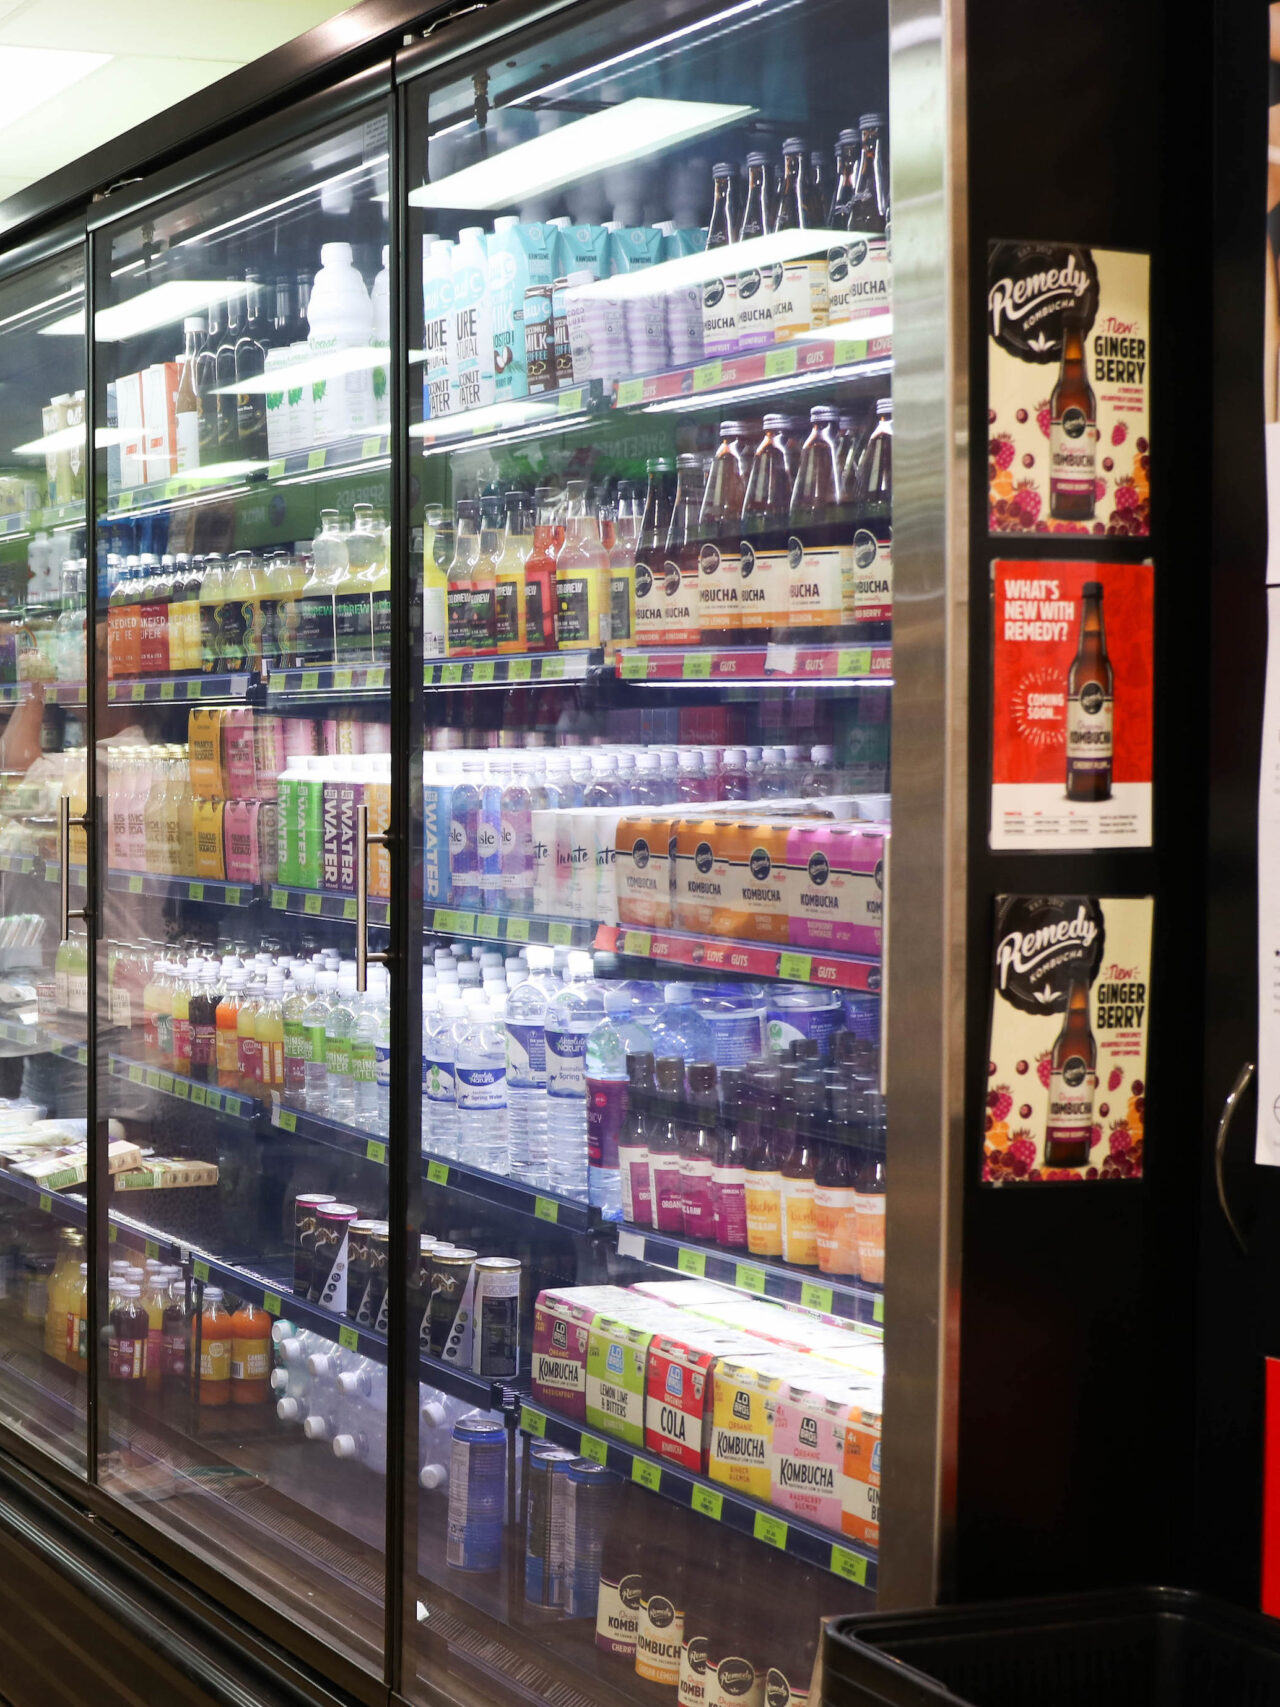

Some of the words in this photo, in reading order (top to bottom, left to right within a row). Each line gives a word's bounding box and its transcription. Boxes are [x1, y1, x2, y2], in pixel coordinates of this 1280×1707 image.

[988, 254, 1091, 337] Remedy
[1023, 299, 1075, 331] KOMBUCHA
[806, 351, 824, 364] GUTS
[1094, 336, 1146, 359] GINGER
[1095, 359, 1145, 384] BERRY
[1004, 579, 1060, 600] WHAT'S
[1004, 601, 1039, 620] NEW
[1040, 602, 1075, 621] WITH
[1004, 621, 1069, 641] REMEDY?
[805, 659, 824, 671] GUTS
[872, 657, 892, 669] LOVE
[1027, 693, 1065, 707] COMING
[278, 799, 288, 862] WATER
[298, 799, 306, 865] WATER
[324, 800, 338, 882] WATER
[341, 801, 354, 885] WATER
[424, 803, 439, 898] WATER
[627, 875, 657, 889] KOMBUCHA
[688, 880, 721, 896] KOMBUCHA
[742, 887, 781, 902] KOMBUCHA
[800, 893, 839, 910] KOMBUCHA
[652, 942, 668, 955] GUTS
[996, 905, 1098, 990] Remedy
[707, 951, 723, 963] LOVE
[731, 954, 748, 967] GUTS
[1029, 950, 1083, 984] KOMBUCHA
[818, 966, 837, 980] GUTS
[1097, 983, 1146, 1004] GINGER
[1097, 1006, 1145, 1029] BERRY
[559, 1072, 580, 1081] Spring
[539, 1357, 579, 1382] KOMBUCHA
[599, 1383, 615, 1399] LEMON
[616, 1387, 629, 1405] LIME
[737, 1393, 749, 1405] LO
[606, 1398, 627, 1418] BITTERS
[734, 1404, 750, 1416] BROS
[660, 1406, 686, 1441] COLA
[728, 1421, 753, 1432] ORGANIC
[803, 1418, 816, 1431] LO
[717, 1432, 765, 1459] KOMBUCHA
[800, 1430, 818, 1444] BROS
[794, 1447, 821, 1460] ORGANIC
[780, 1459, 833, 1488] KOMBUCHA
[612, 1643, 636, 1654] CHERRY
[720, 1669, 752, 1688] Remedy
